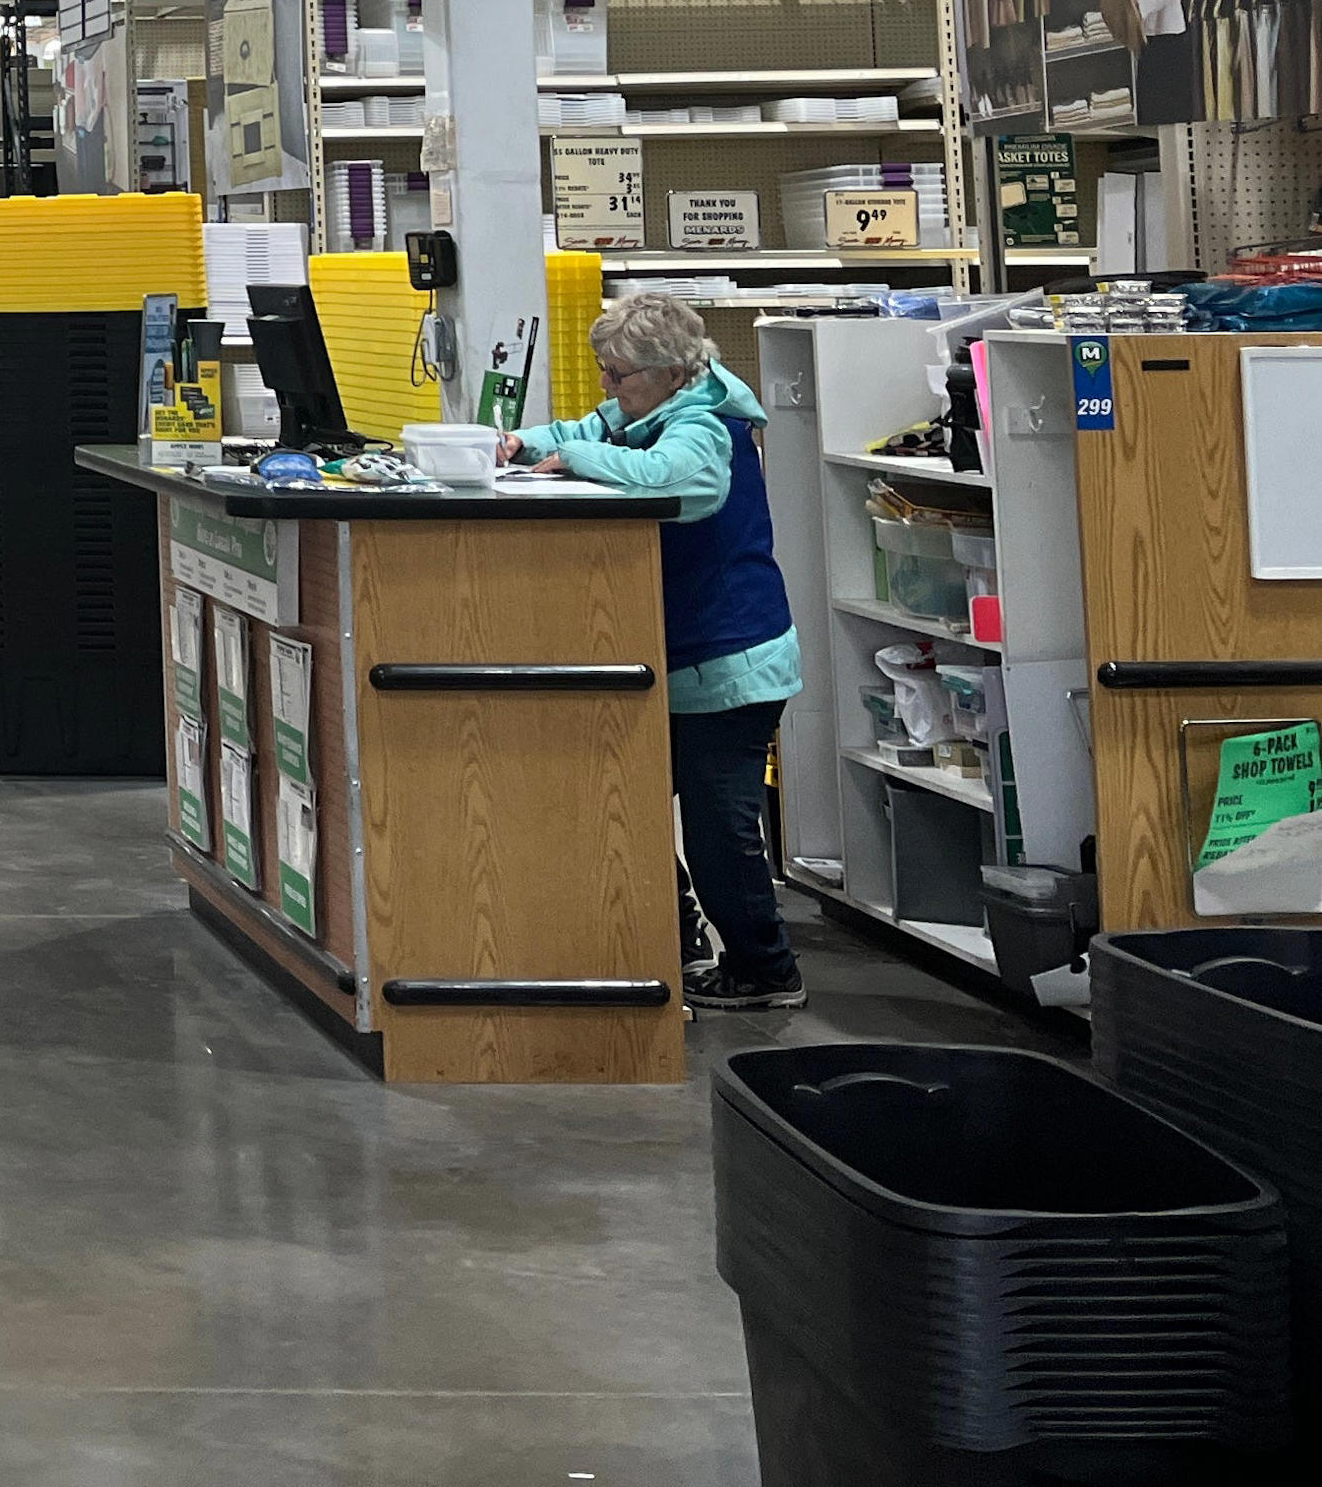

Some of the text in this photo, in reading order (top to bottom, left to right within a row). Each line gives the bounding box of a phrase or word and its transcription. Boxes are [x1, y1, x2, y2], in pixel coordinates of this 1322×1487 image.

[621, 147, 638, 155] DUTY
[998, 151, 1069, 163] ASKET TOTES
[690, 199, 736, 207] THANK YOU
[684, 212, 743, 221] FOR SHOPPING
[684, 225, 745, 235] MENARDS
[1078, 398, 1113, 415] 299
[1254, 733, 1297, 756] 6-PACK
[1233, 761, 1267, 780] SHOP
[1271, 752, 1314, 775] TOWELS
[1218, 795, 1243, 807] PRICE
